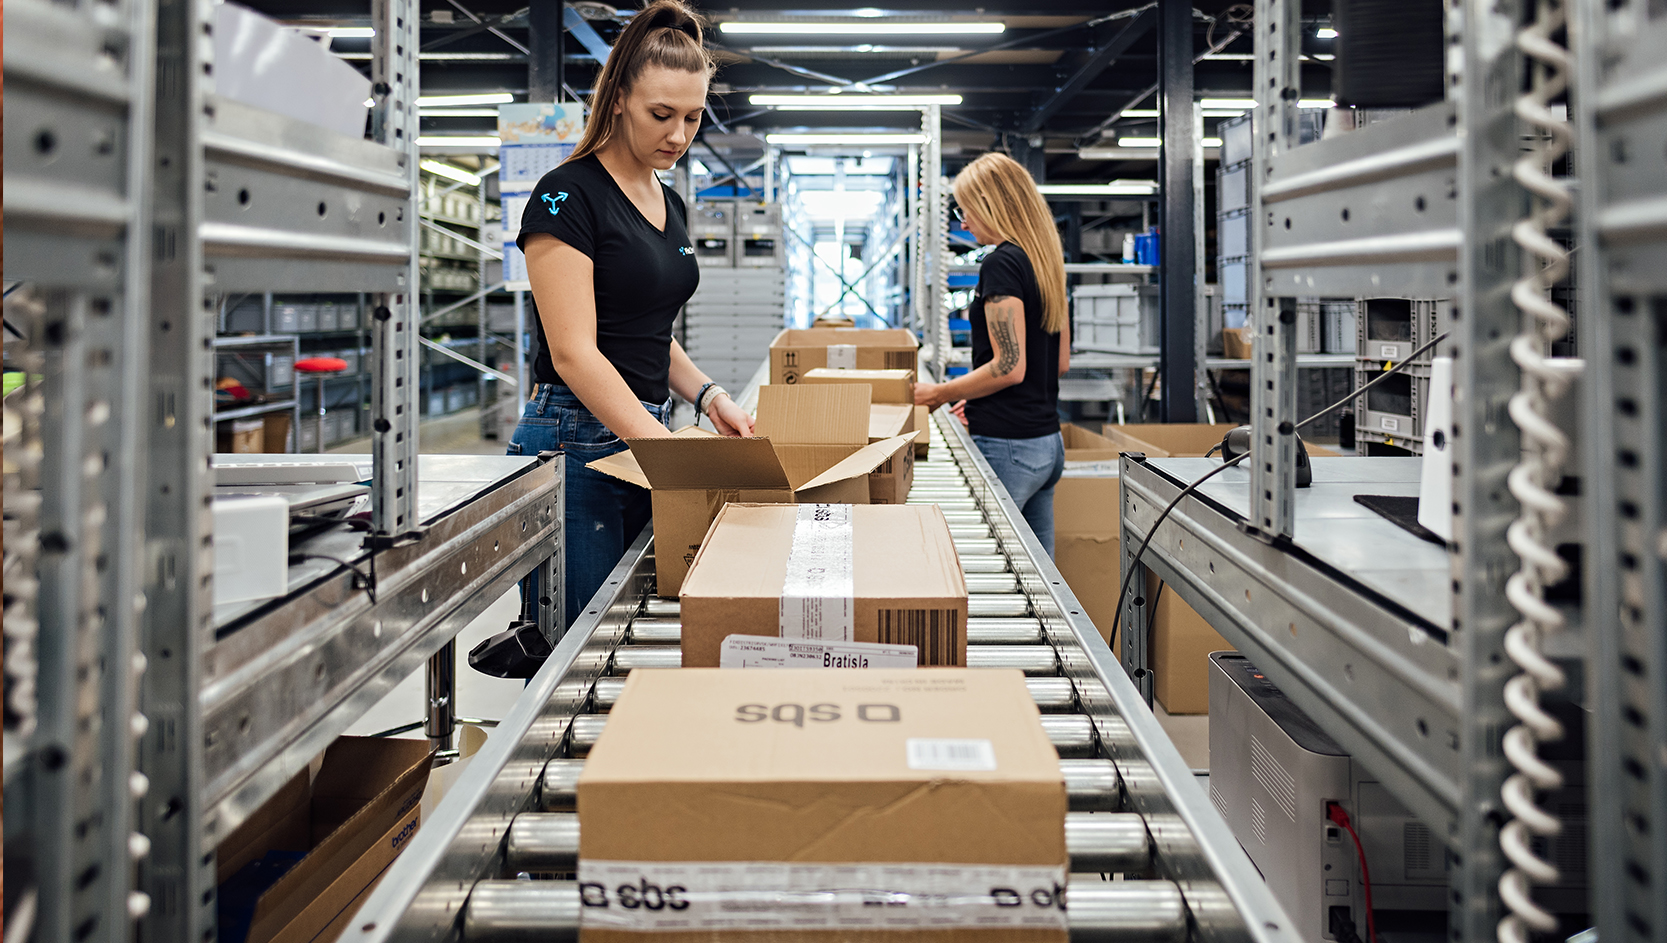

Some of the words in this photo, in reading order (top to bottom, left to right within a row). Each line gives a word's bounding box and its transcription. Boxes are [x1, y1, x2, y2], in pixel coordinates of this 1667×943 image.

[823, 652, 869, 668] Bratisla
[392, 817, 418, 848] brother
[616, 877, 690, 911] sbs
